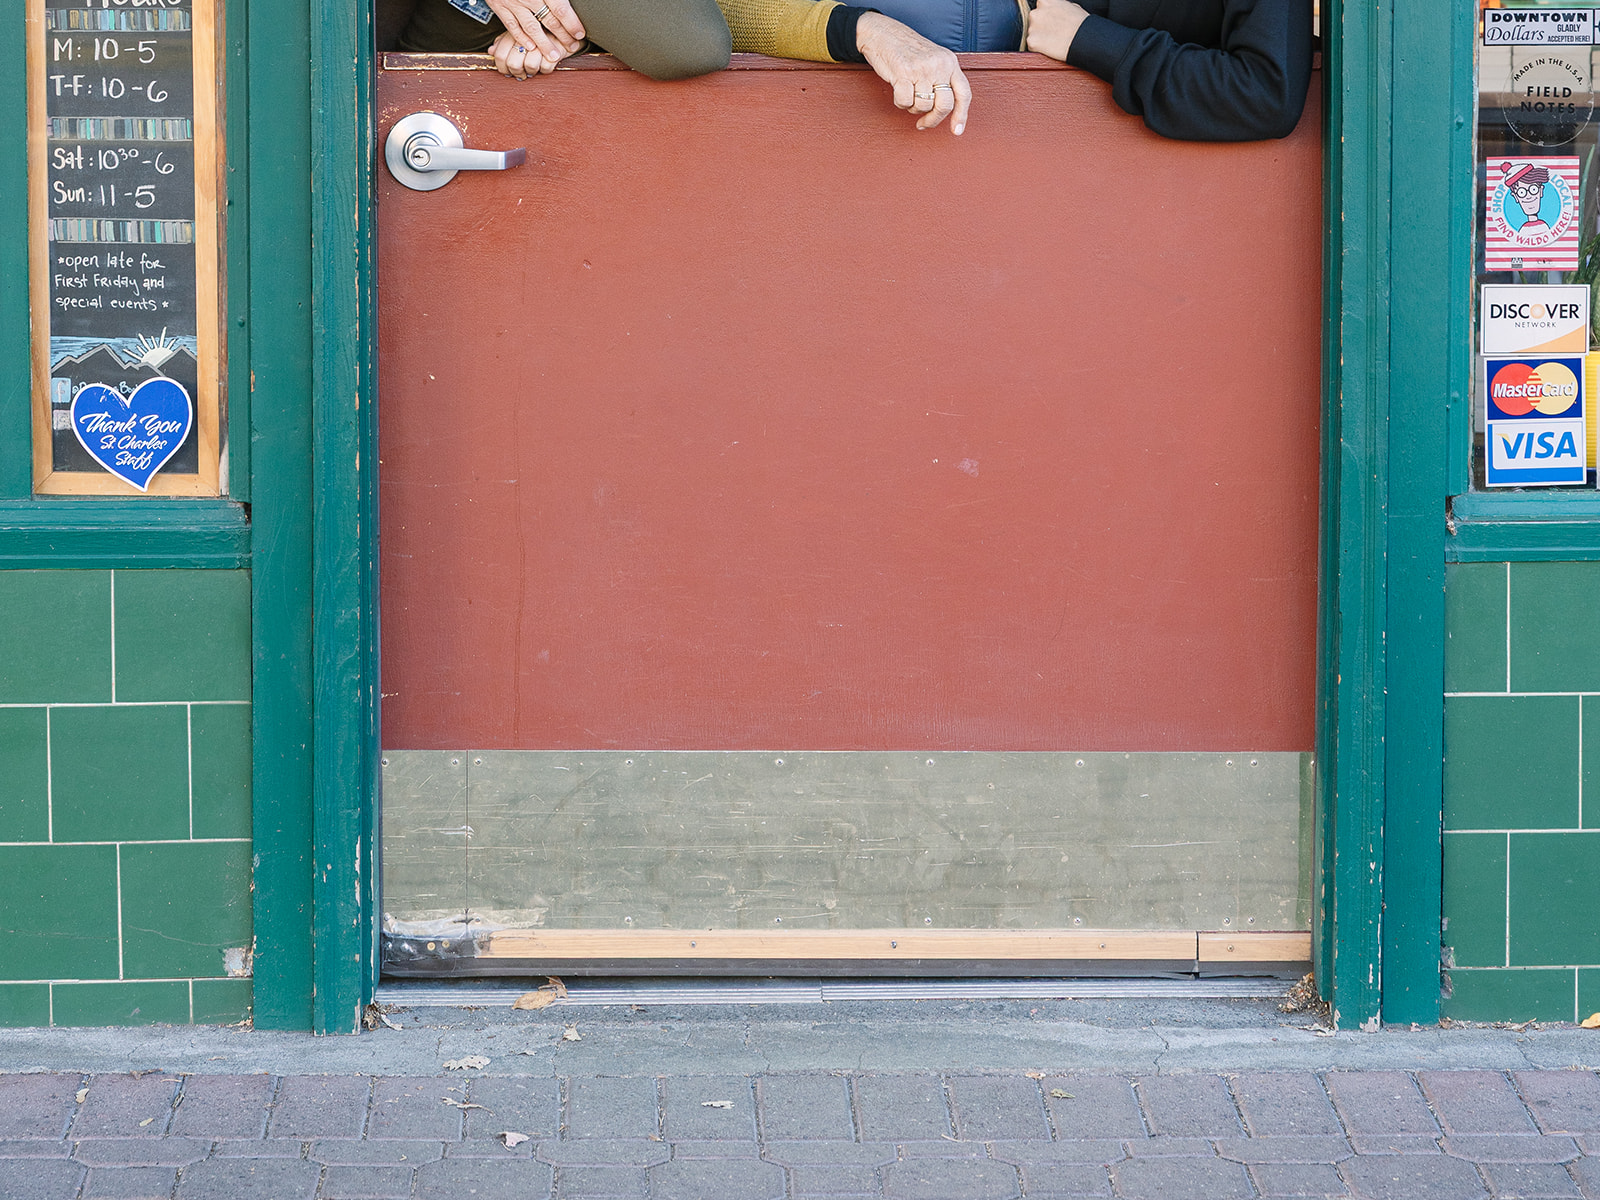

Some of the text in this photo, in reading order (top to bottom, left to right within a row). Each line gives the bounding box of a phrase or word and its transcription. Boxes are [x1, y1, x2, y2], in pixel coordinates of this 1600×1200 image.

[1491, 13, 1587, 22] DOWNTOWN
[1486, 25, 1545, 41] Dollars
[1557, 24, 1581, 32] GLADLY
[1513, 58, 1584, 85] MADE IN THE U.S.A.
[1527, 86, 1572, 98] FIELD
[1520, 101, 1575, 113] NOTES
[1492, 174, 1572, 213] SHOP LOCAL
[1495, 211, 1572, 246] FIND WALDO HERE!
[107, 251, 134, 269] late
[143, 275, 165, 290] and
[56, 295, 158, 311] special events
[1490, 303, 1580, 319] DISCOVER
[1493, 381, 1575, 398] MasterCard
[79, 411, 182, 436] Thank You
[117, 435, 167, 450] Charles
[1496, 431, 1577, 459] VISA
[115, 451, 154, 470] Staff
